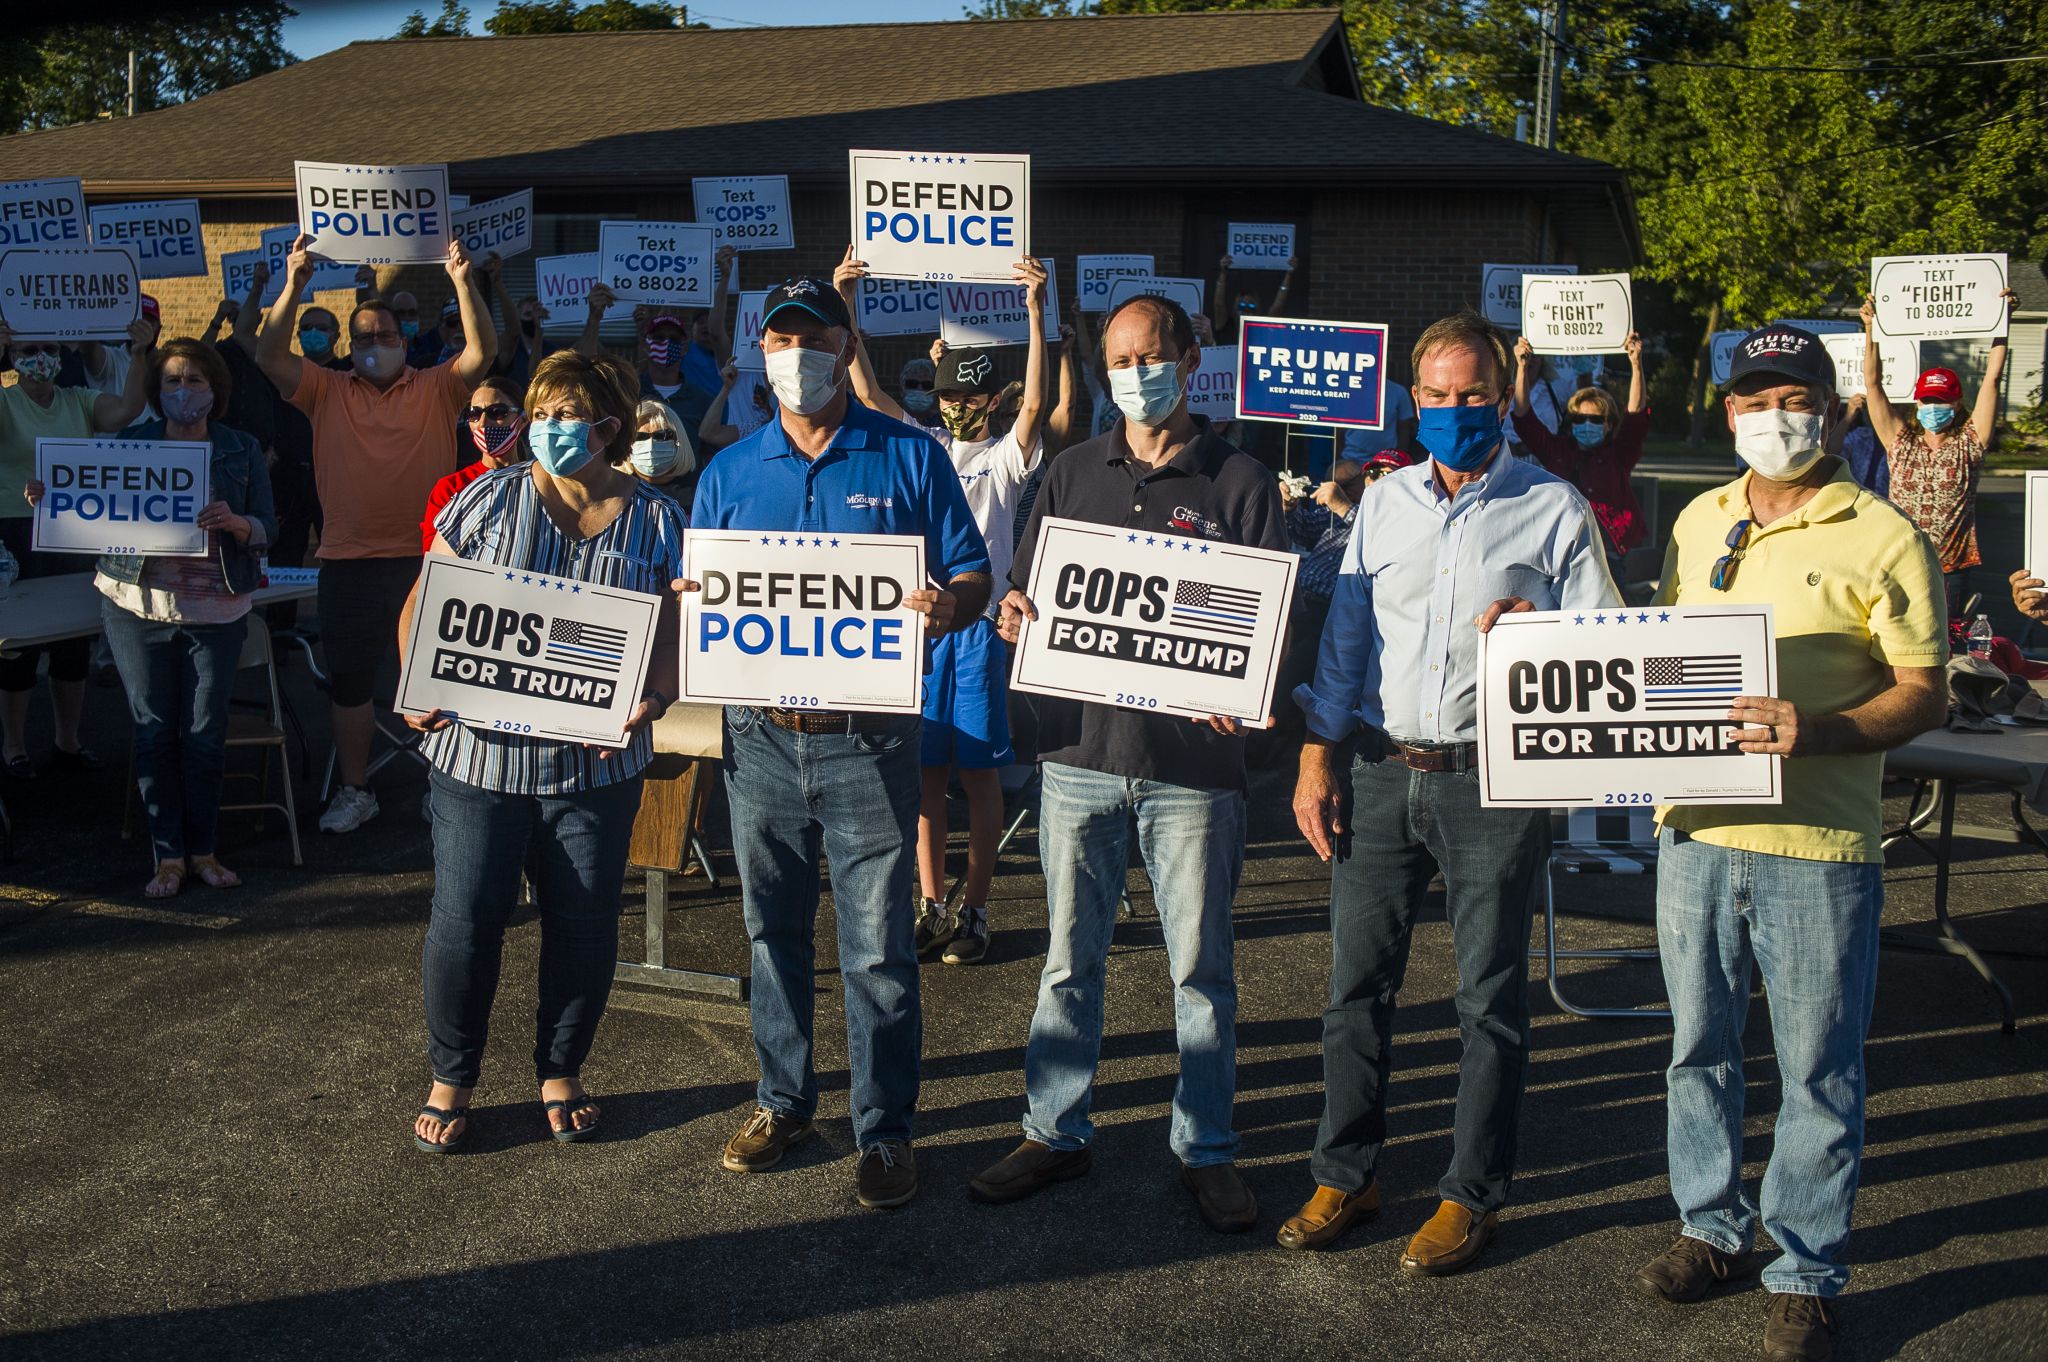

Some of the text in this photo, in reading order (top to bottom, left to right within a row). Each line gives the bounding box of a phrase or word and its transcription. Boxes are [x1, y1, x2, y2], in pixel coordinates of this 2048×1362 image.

[310, 186, 436, 210] DEFEND
[722, 189, 755, 202] Text
[866, 180, 1013, 211] DEFEND
[0, 198, 74, 222] FEND
[706, 205, 776, 222] “COPS”
[0, 218, 79, 245] OLICE
[99, 218, 191, 240] DEFEND
[311, 211, 439, 236] POLICE
[453, 206, 525, 237] DEFEND
[727, 223, 779, 238] 88022
[866, 211, 1014, 247] POLICE
[460, 220, 525, 251] OLICE
[638, 236, 676, 251] Text
[1234, 233, 1289, 244] DEFEND
[101, 236, 195, 259] LICE
[1233, 244, 1289, 257] POLICE
[614, 253, 698, 273] “COPS”
[19, 273, 129, 297] VETERANS
[544, 273, 598, 297] Wom
[613, 274, 698, 292] to 88022
[924, 272, 954, 280] 2020
[1923, 269, 1955, 282] TEXT
[864, 279, 937, 294] DEFEN
[1560, 291, 1584, 302] TEXT
[1902, 282, 1976, 303] “FIGHT”
[33, 299, 118, 310] FOR TRUMP
[555, 297, 579, 307] FOR
[865, 292, 939, 315] POLIC
[946, 285, 1050, 313] Wome
[961, 311, 1029, 326] FOR TRU
[1543, 303, 1604, 321] “FIGHT”
[1905, 303, 1973, 319] TO 88022
[1547, 322, 1604, 336] TO 88022
[1745, 334, 1809, 352] TRUMP
[1248, 345, 1376, 373] TRUMP
[1258, 369, 1363, 389] PENCE
[1842, 376, 1853, 386] TO
[1289, 388, 1322, 397] AMERICA
[1299, 413, 1318, 421] 2020
[51, 464, 194, 491] DEFEND
[50, 492, 194, 523] POLICE
[1173, 506, 1217, 530] Greene
[107, 546, 136, 554] 2020
[701, 569, 903, 611] DEFEND
[1054, 563, 1169, 623] COPS
[438, 598, 544, 658] COPS
[700, 612, 903, 660] POLICE
[1053, 623, 1245, 673] FOR TRUMP
[437, 655, 612, 703] FOR TRUMP
[1508, 658, 1637, 714] COPS
[780, 695, 818, 707] 2020
[1115, 693, 1157, 708] 2020
[493, 719, 532, 734] 2020
[1518, 725, 1738, 754] FOR TRUMP
[1605, 793, 1652, 804] 2020
